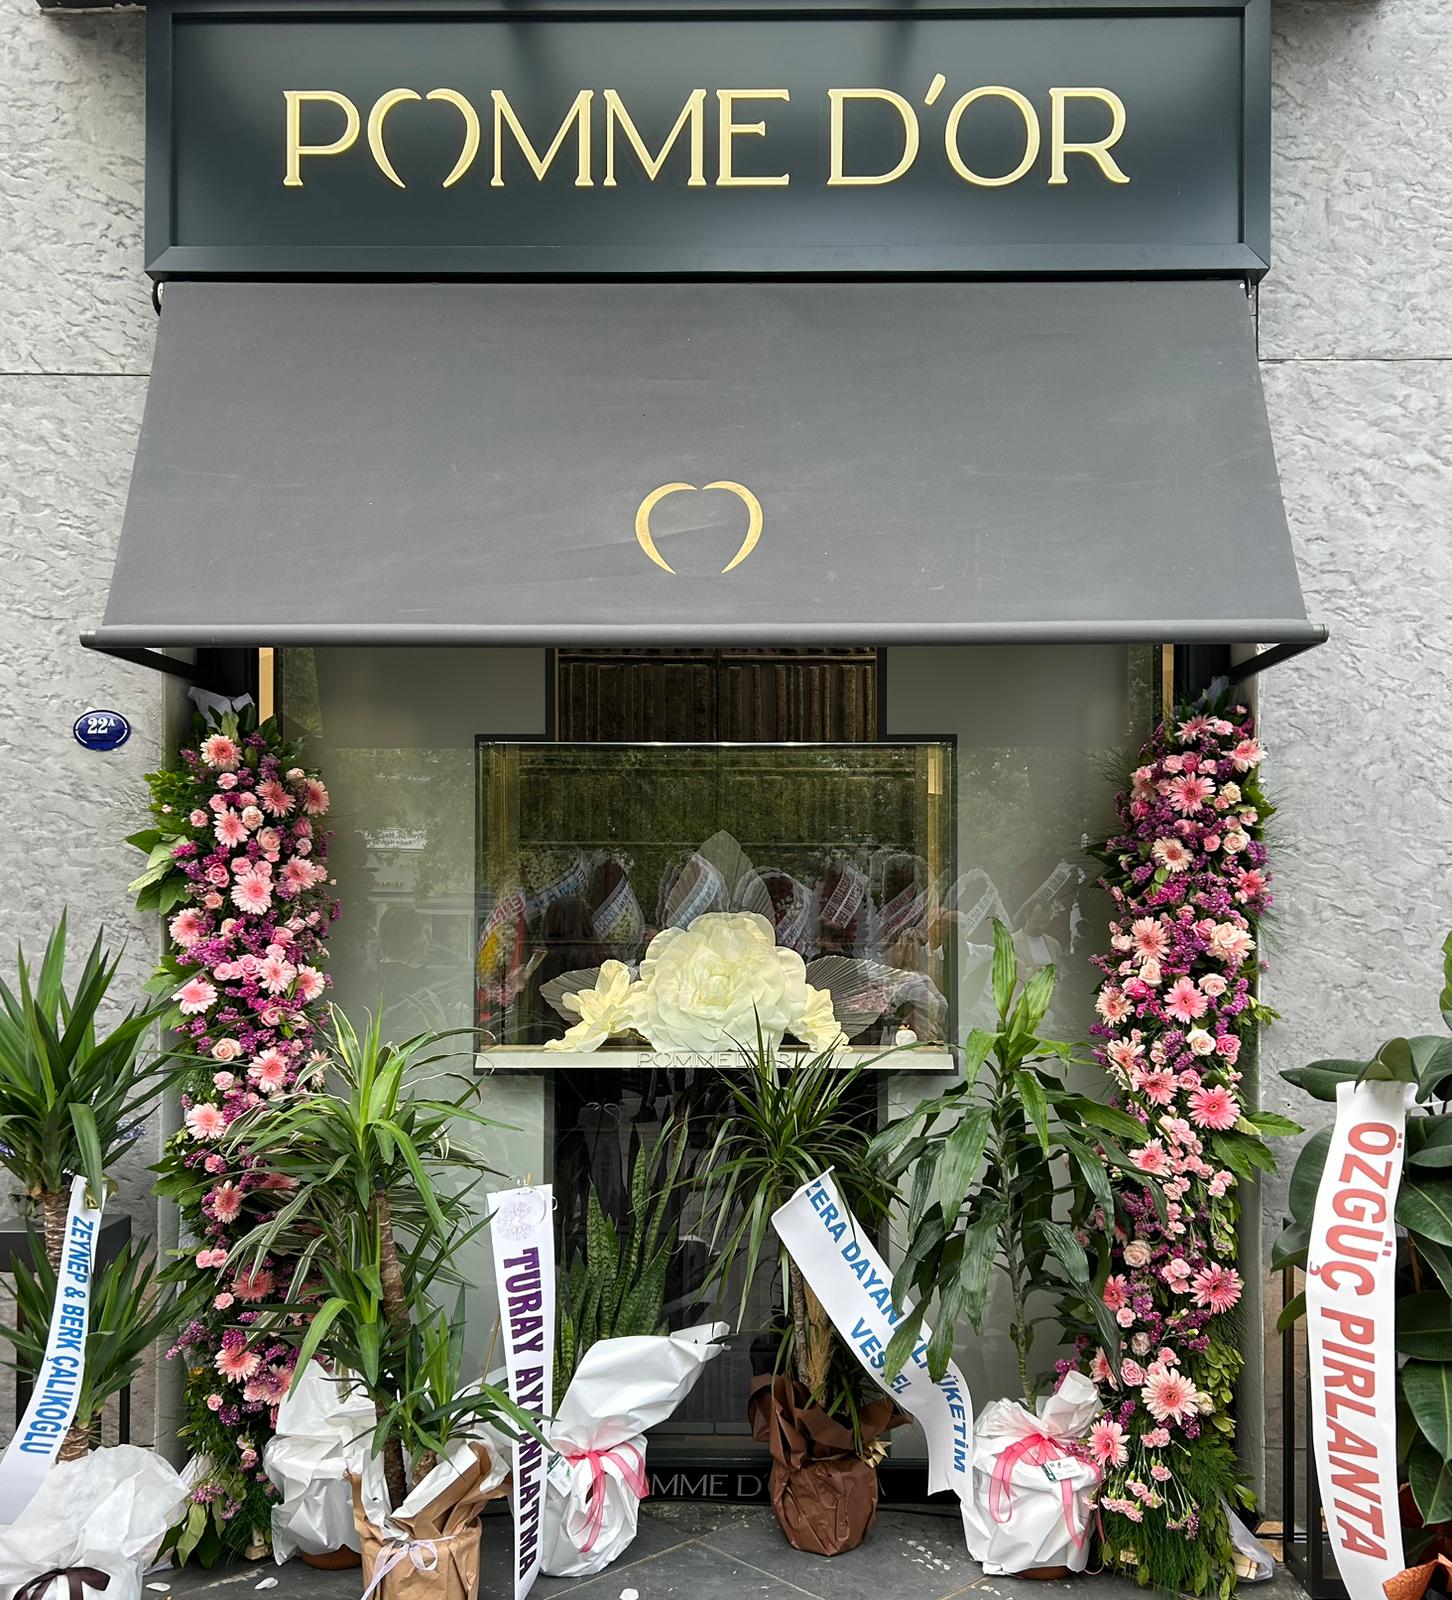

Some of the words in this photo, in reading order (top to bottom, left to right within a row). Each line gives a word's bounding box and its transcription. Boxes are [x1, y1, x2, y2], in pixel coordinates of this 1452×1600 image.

[283, 88, 790, 187] POMME
[827, 73, 1131, 186] D'OR
[87, 717, 116, 735] 22A
[638, 1051, 732, 1067] POMME
[1309, 1122, 1403, 1296] ÖZGÜÇ
[67, 1216, 94, 1284] ZEYNEP
[56, 1303, 85, 1352] BERK
[64, 1286, 86, 1299] &
[503, 1246, 543, 1355] TURAY
[851, 1317, 912, 1394] VESEL
[19, 1355, 80, 1455] ÇALIKOĞLU
[936, 1371, 969, 1473] ÜKETİM
[1321, 1307, 1388, 1560] PIRLANTA
[651, 1473, 729, 1497] MME
